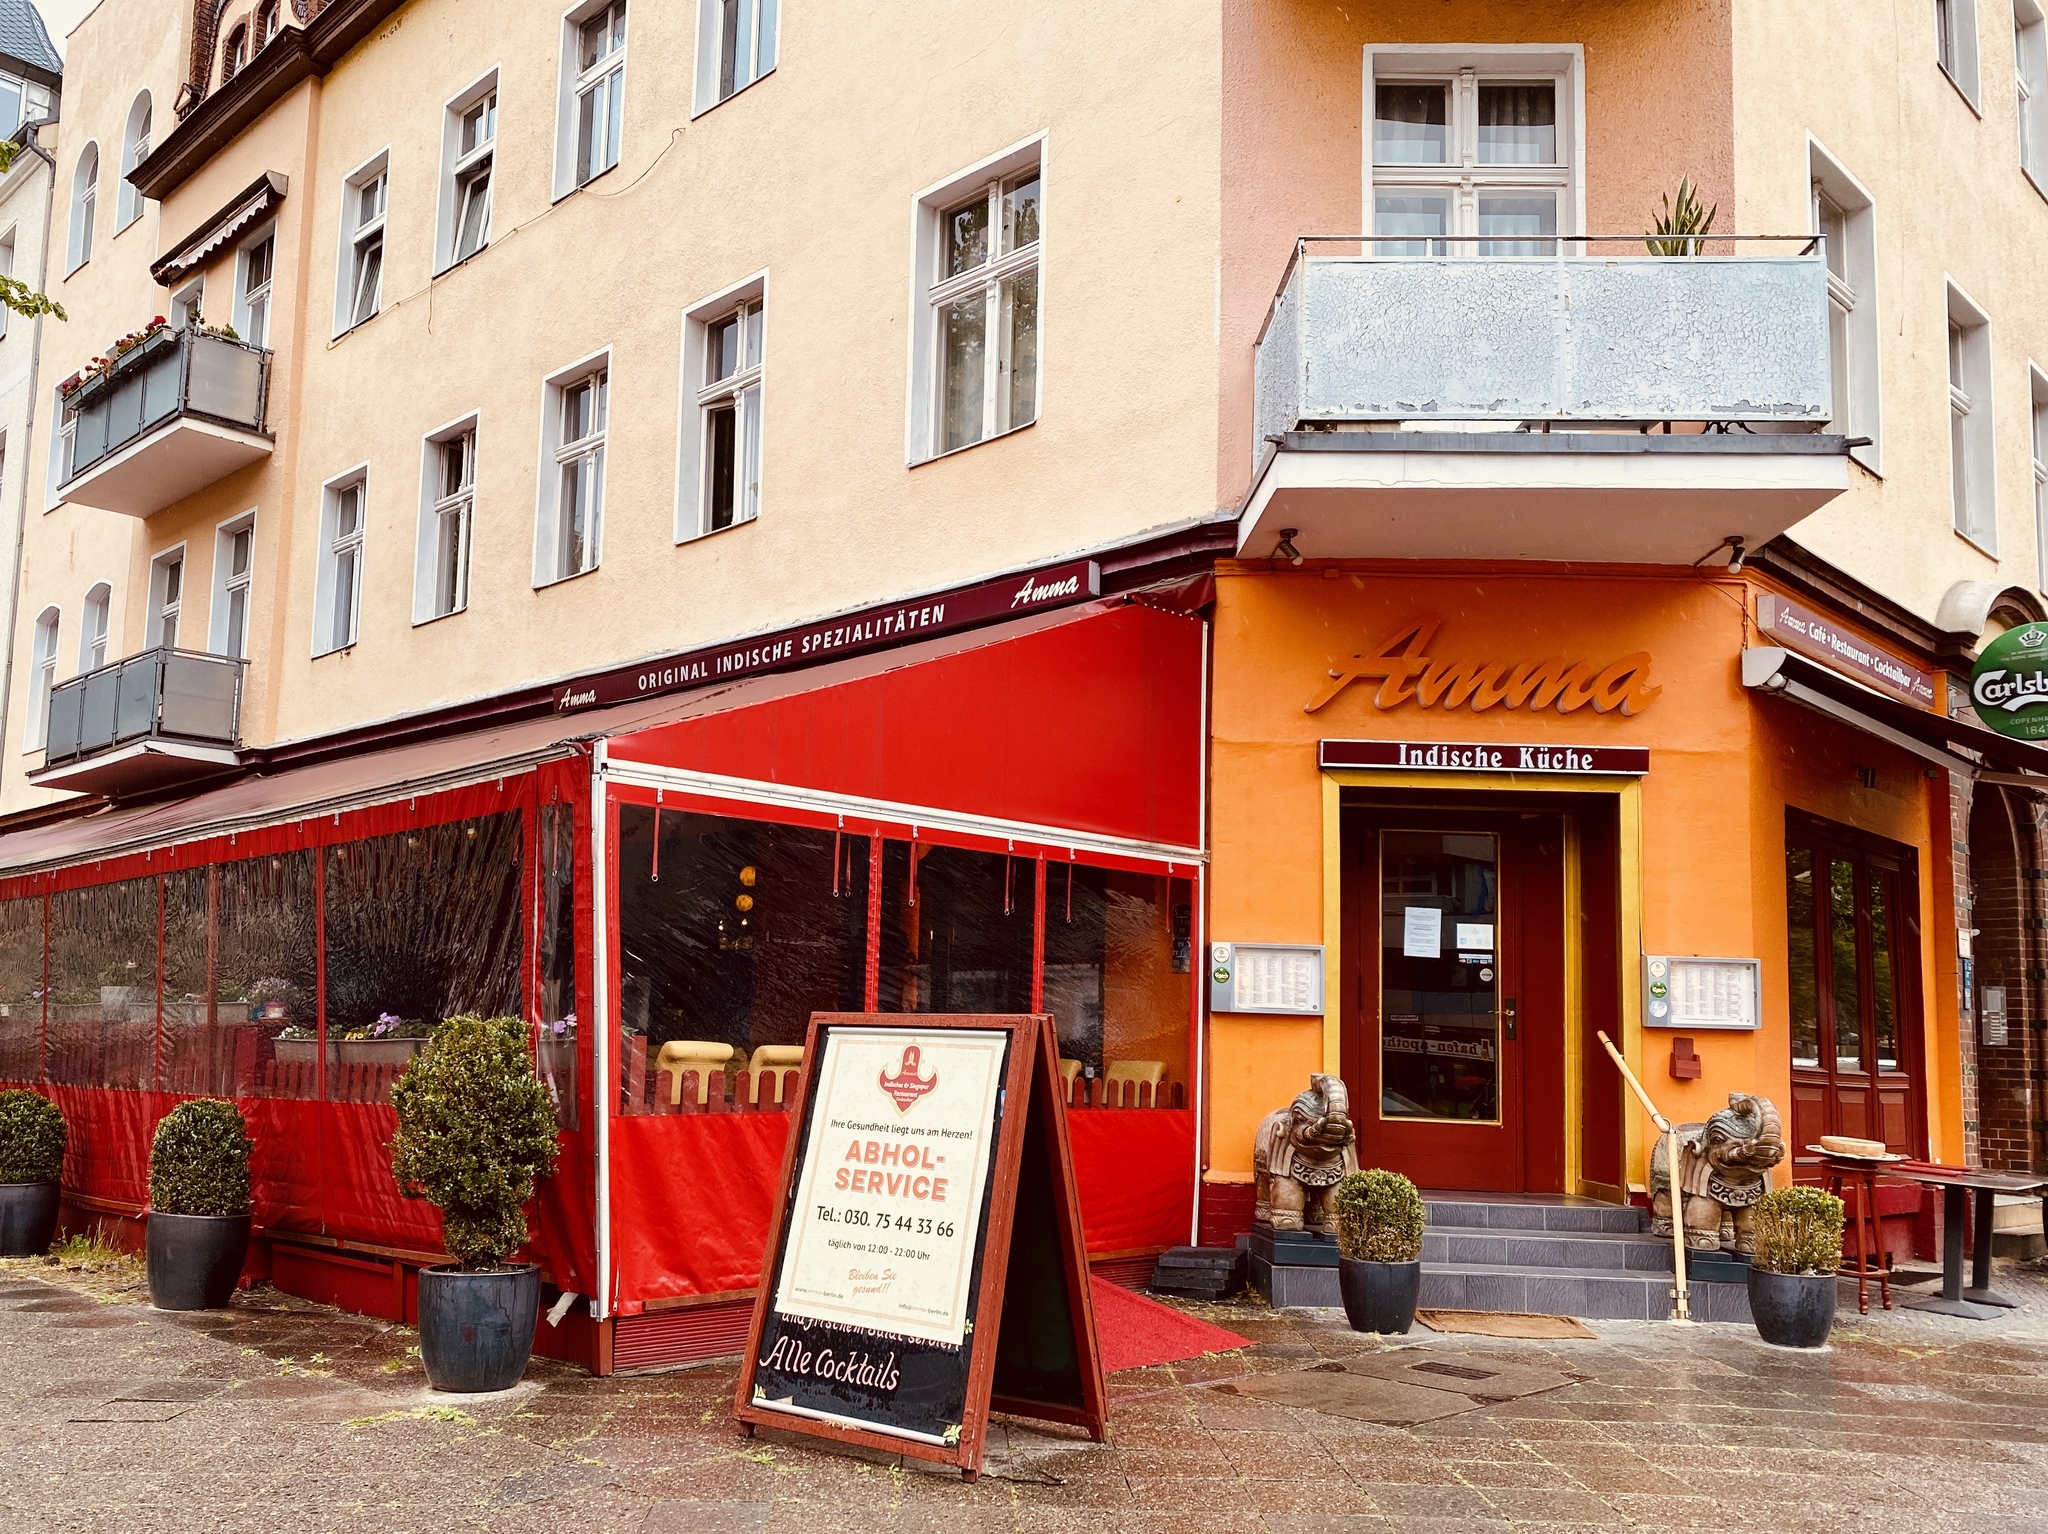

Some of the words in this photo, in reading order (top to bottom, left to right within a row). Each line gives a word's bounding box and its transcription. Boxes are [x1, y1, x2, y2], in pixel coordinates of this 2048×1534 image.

[1011, 575, 1080, 609] Amma
[637, 662, 709, 692] ORIGINAL
[716, 637, 792, 675] INDISCHE
[801, 603, 946, 654] SPEZIALITÄTEN
[1809, 622, 1827, 645] Café
[1831, 632, 1870, 667] Restaurant
[1874, 656, 1911, 688] Cocktailbar
[1303, 615, 1663, 717] Amma
[559, 687, 597, 711] Amma
[1398, 744, 1503, 769] Indische
[1519, 747, 1593, 770] Küche
[831, 1119, 845, 1128] Ihre
[847, 1120, 889, 1133] Gesundheit
[891, 1123, 909, 1136] liegt
[911, 1127, 925, 1135] uns
[926, 1128, 939, 1137] am
[941, 1128, 973, 1140] Herzen!
[844, 1140, 946, 1171] ABHOL-
[834, 1167, 949, 1202] SERVICE
[817, 1205, 842, 1223] Tel.:
[844, 1209, 871, 1227] 030.
[876, 1213, 891, 1229] 75
[894, 1215, 912, 1232] 44
[916, 1218, 933, 1235] 33
[936, 1221, 954, 1238] 66
[828, 1238, 852, 1251] täglich
[853, 1243, 866, 1251] von
[868, 1243, 889, 1255] 12:00
[894, 1247, 916, 1260] 22:00
[917, 1250, 931, 1261] Uhr
[848, 1268, 880, 1282] Bleiben
[881, 1268, 898, 1280] Sie
[852, 1282, 891, 1298] gesund!!
[759, 1335, 810, 1374] Alle
[815, 1349, 900, 1391] Cocktails
